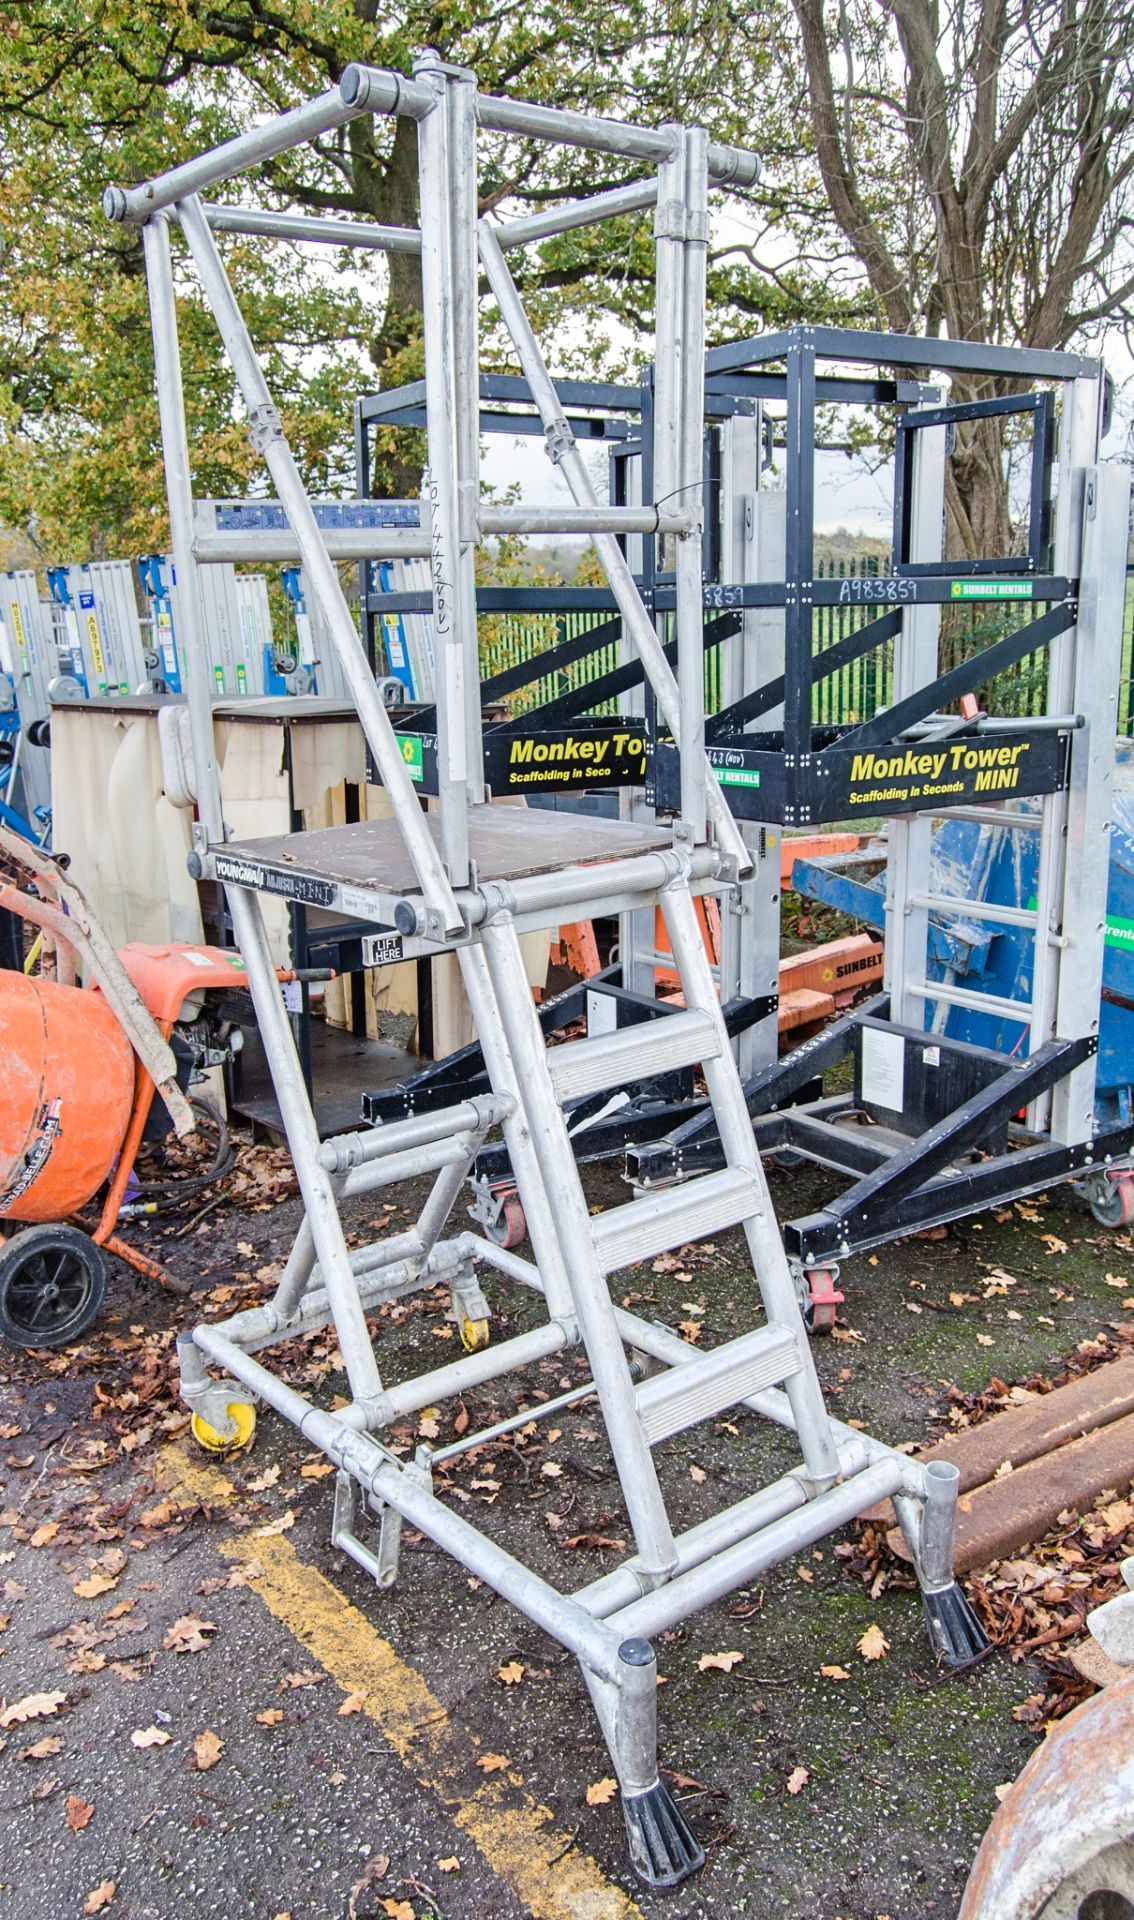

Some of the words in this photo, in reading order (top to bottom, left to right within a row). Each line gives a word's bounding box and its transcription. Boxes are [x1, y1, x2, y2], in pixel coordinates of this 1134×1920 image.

[432, 524, 445, 578] 442
[703, 586, 744, 607] 3859
[839, 580, 917, 602] A983859
[963, 584, 997, 595] SUNBELT
[998, 584, 1032, 595] RENTALS
[509, 737, 610, 763] Monkey
[509, 770, 570, 783] Scaffolding
[572, 768, 583, 778] in
[725, 771, 760, 784] RENTALS
[850, 751, 948, 782] Monkey
[974, 767, 1020, 792] MINI
[849, 788, 908, 804] Scaffolding
[910, 786, 920, 796] in
[922, 781, 965, 795] Seconds
[375, 949, 402, 962] HERE
[376, 938, 398, 952] LIFT
[835, 952, 884, 979] SUNBELT
[778, 1030, 833, 1067] A983859
